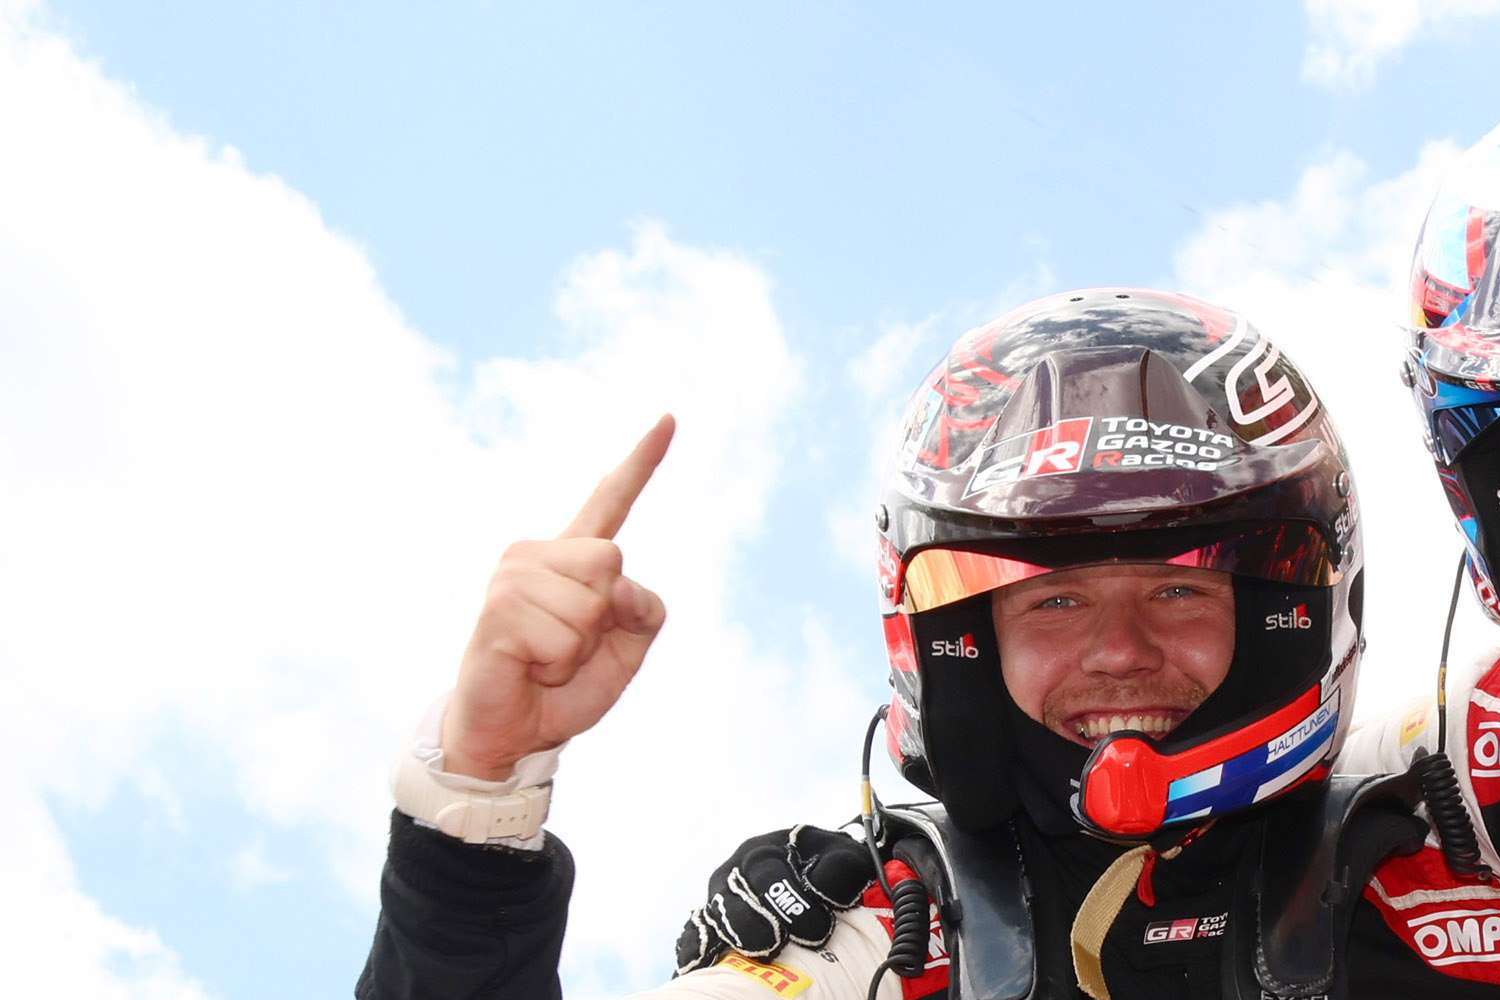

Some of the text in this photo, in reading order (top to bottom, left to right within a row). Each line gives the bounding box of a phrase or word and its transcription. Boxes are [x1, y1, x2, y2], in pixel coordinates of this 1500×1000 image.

[1099, 416, 1234, 448] TOYOTA
[1096, 434, 1222, 459] GAZOO
[1092, 451, 1218, 472] Racing
[768, 881, 805, 916] OMP
[1147, 925, 1193, 941] GR
